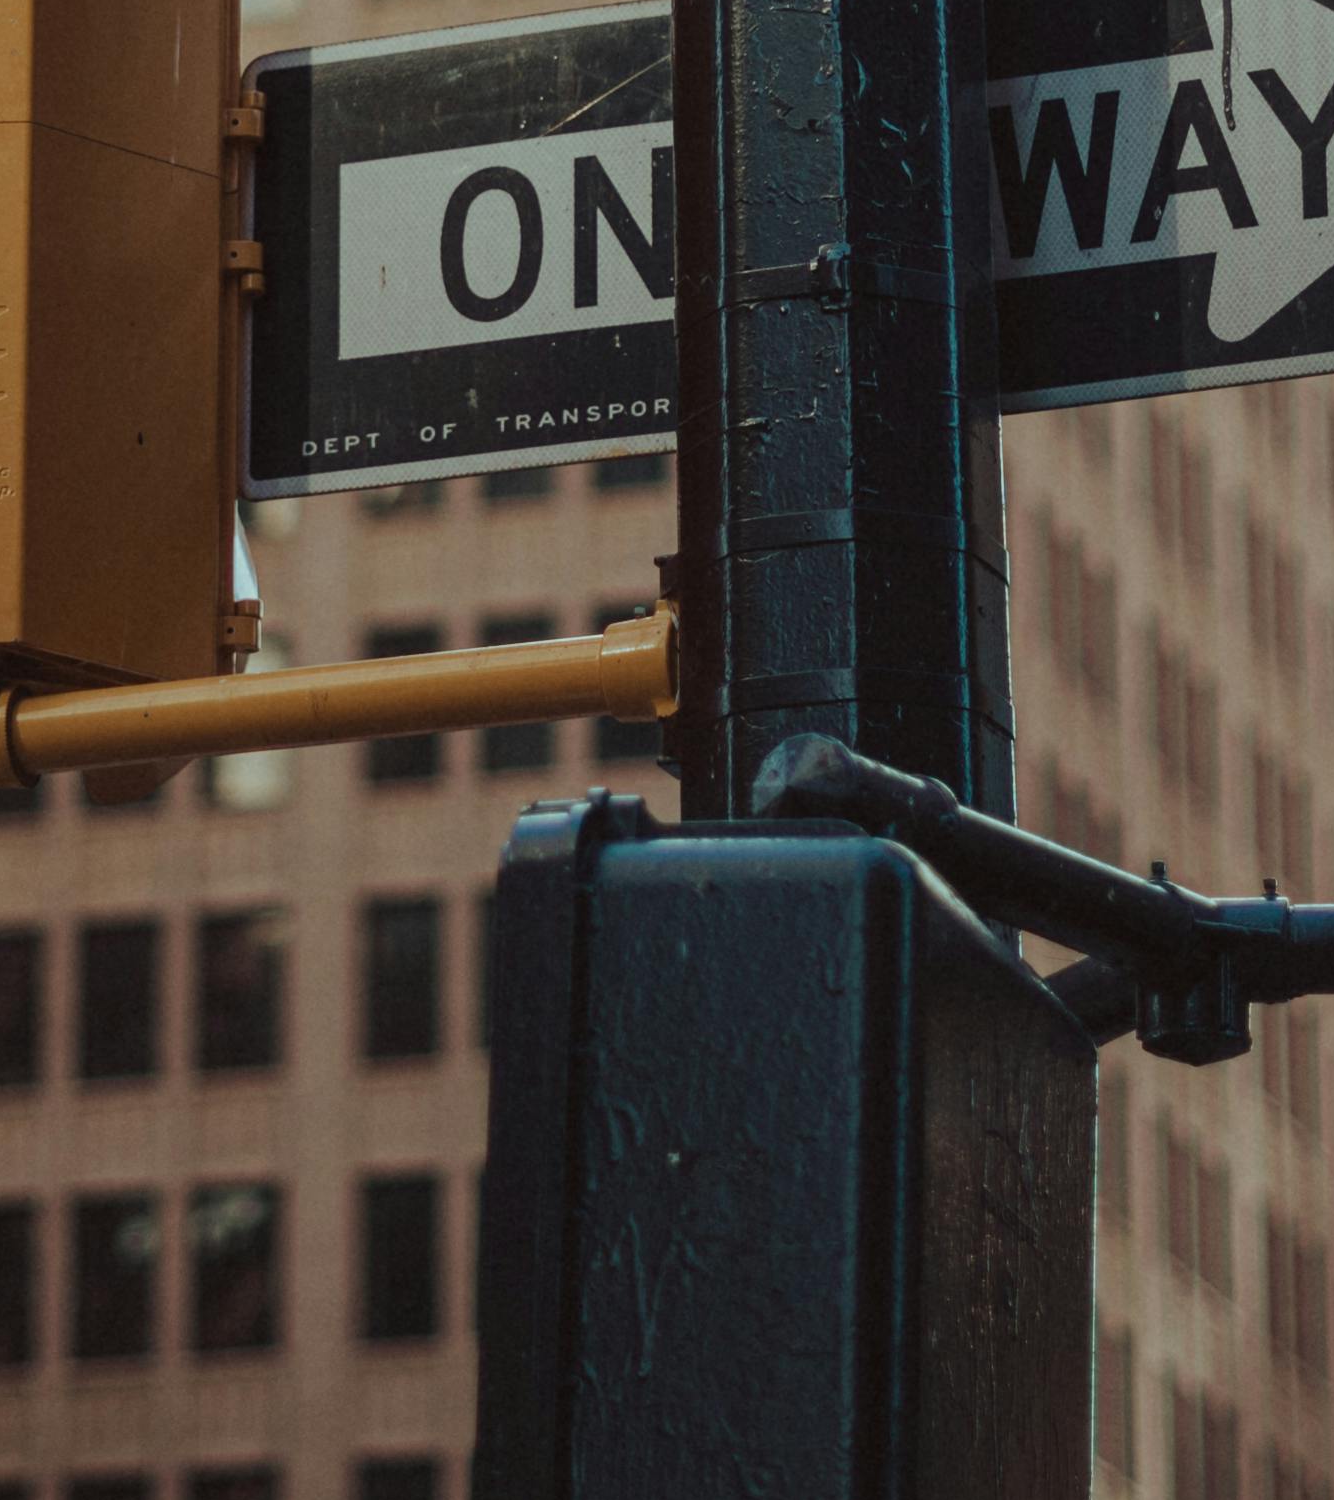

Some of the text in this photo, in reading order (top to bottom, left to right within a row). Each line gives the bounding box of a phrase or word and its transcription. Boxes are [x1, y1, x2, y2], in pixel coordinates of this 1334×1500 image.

[440, 146, 675, 323] ON
[302, 398, 672, 457] DEPT OF TRANSPOR
